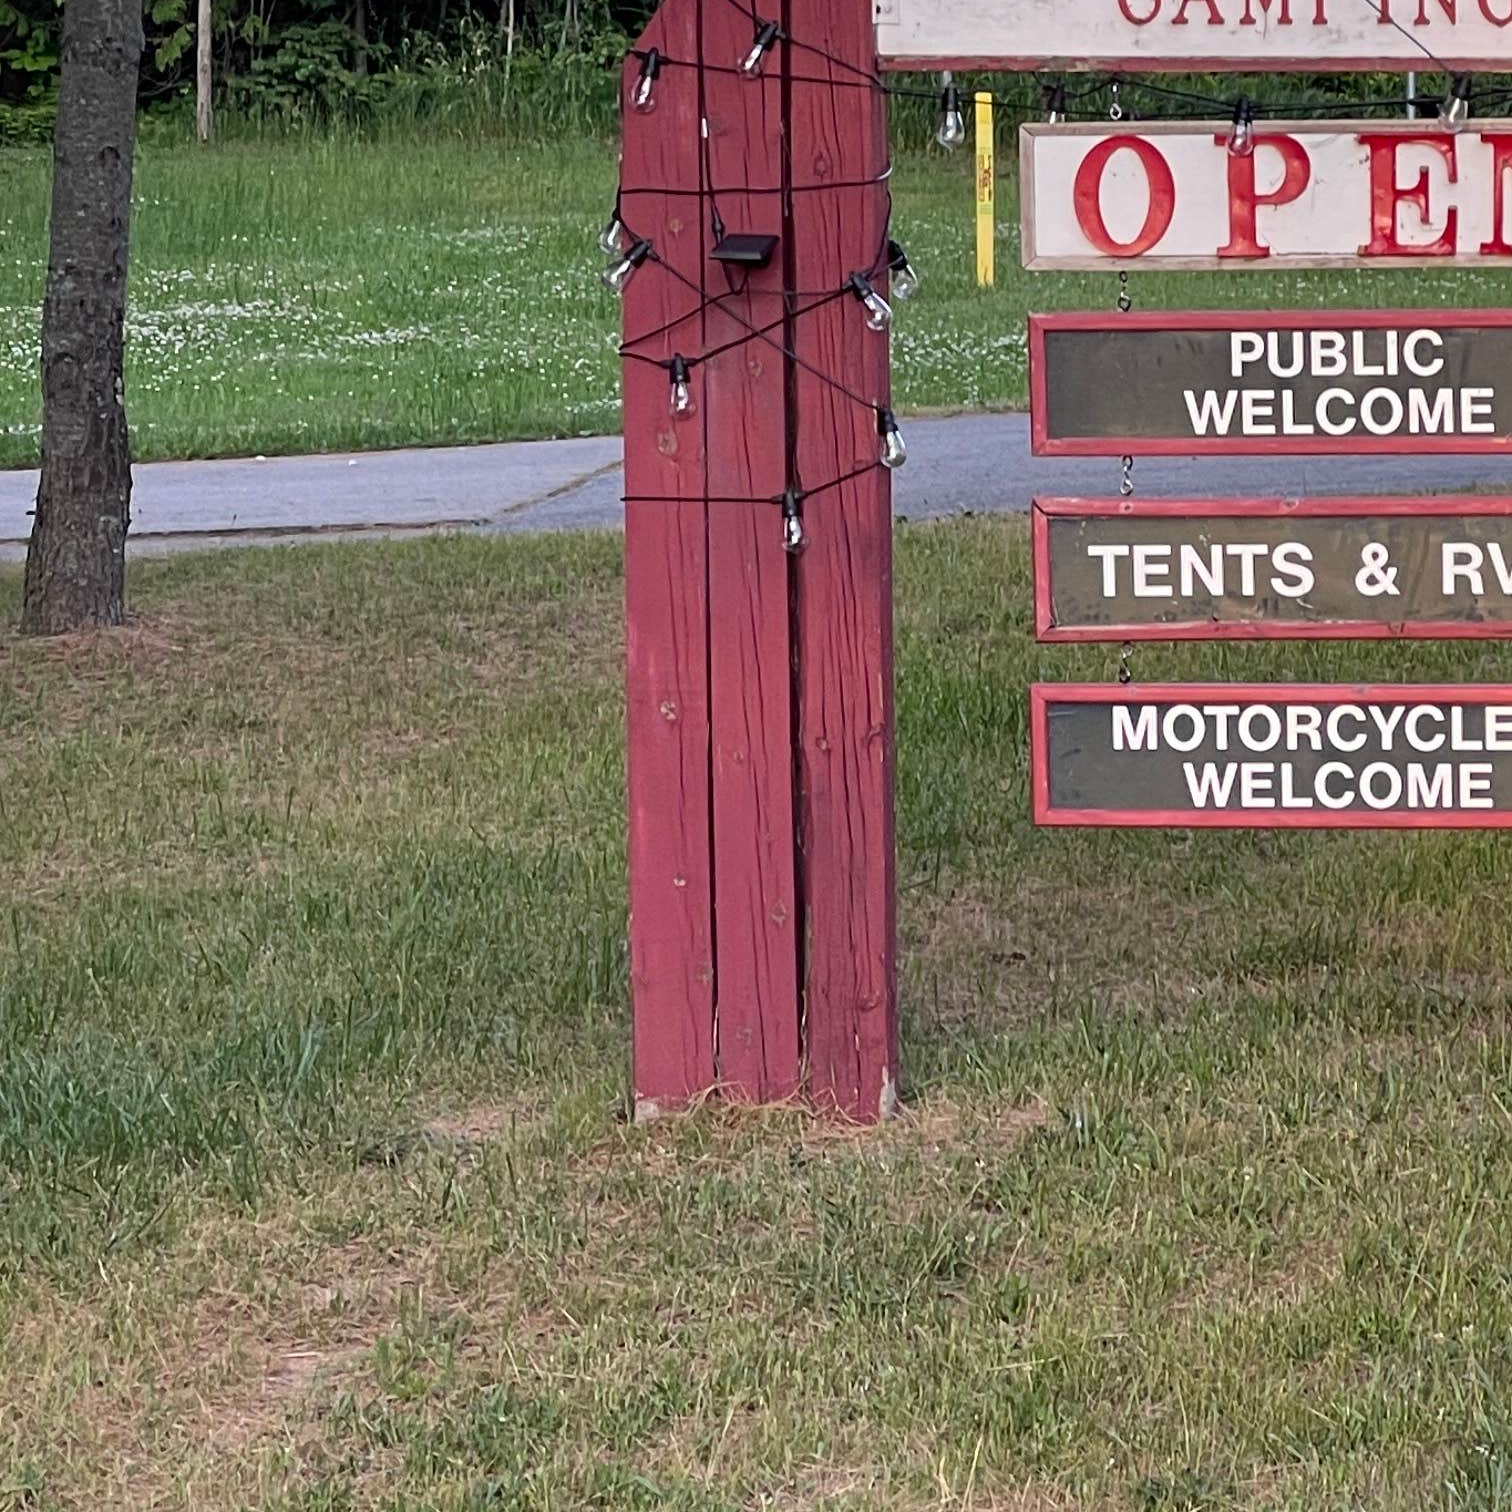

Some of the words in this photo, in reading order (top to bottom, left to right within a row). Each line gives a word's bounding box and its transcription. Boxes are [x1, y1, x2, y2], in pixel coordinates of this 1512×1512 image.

[1230, 330, 1445, 378] PUBLIC
[1184, 388, 1496, 436] WELCOME
[1087, 543, 1315, 597] TENTS
[1355, 543, 1400, 597] &
[1183, 761, 1494, 810] WELCOME
